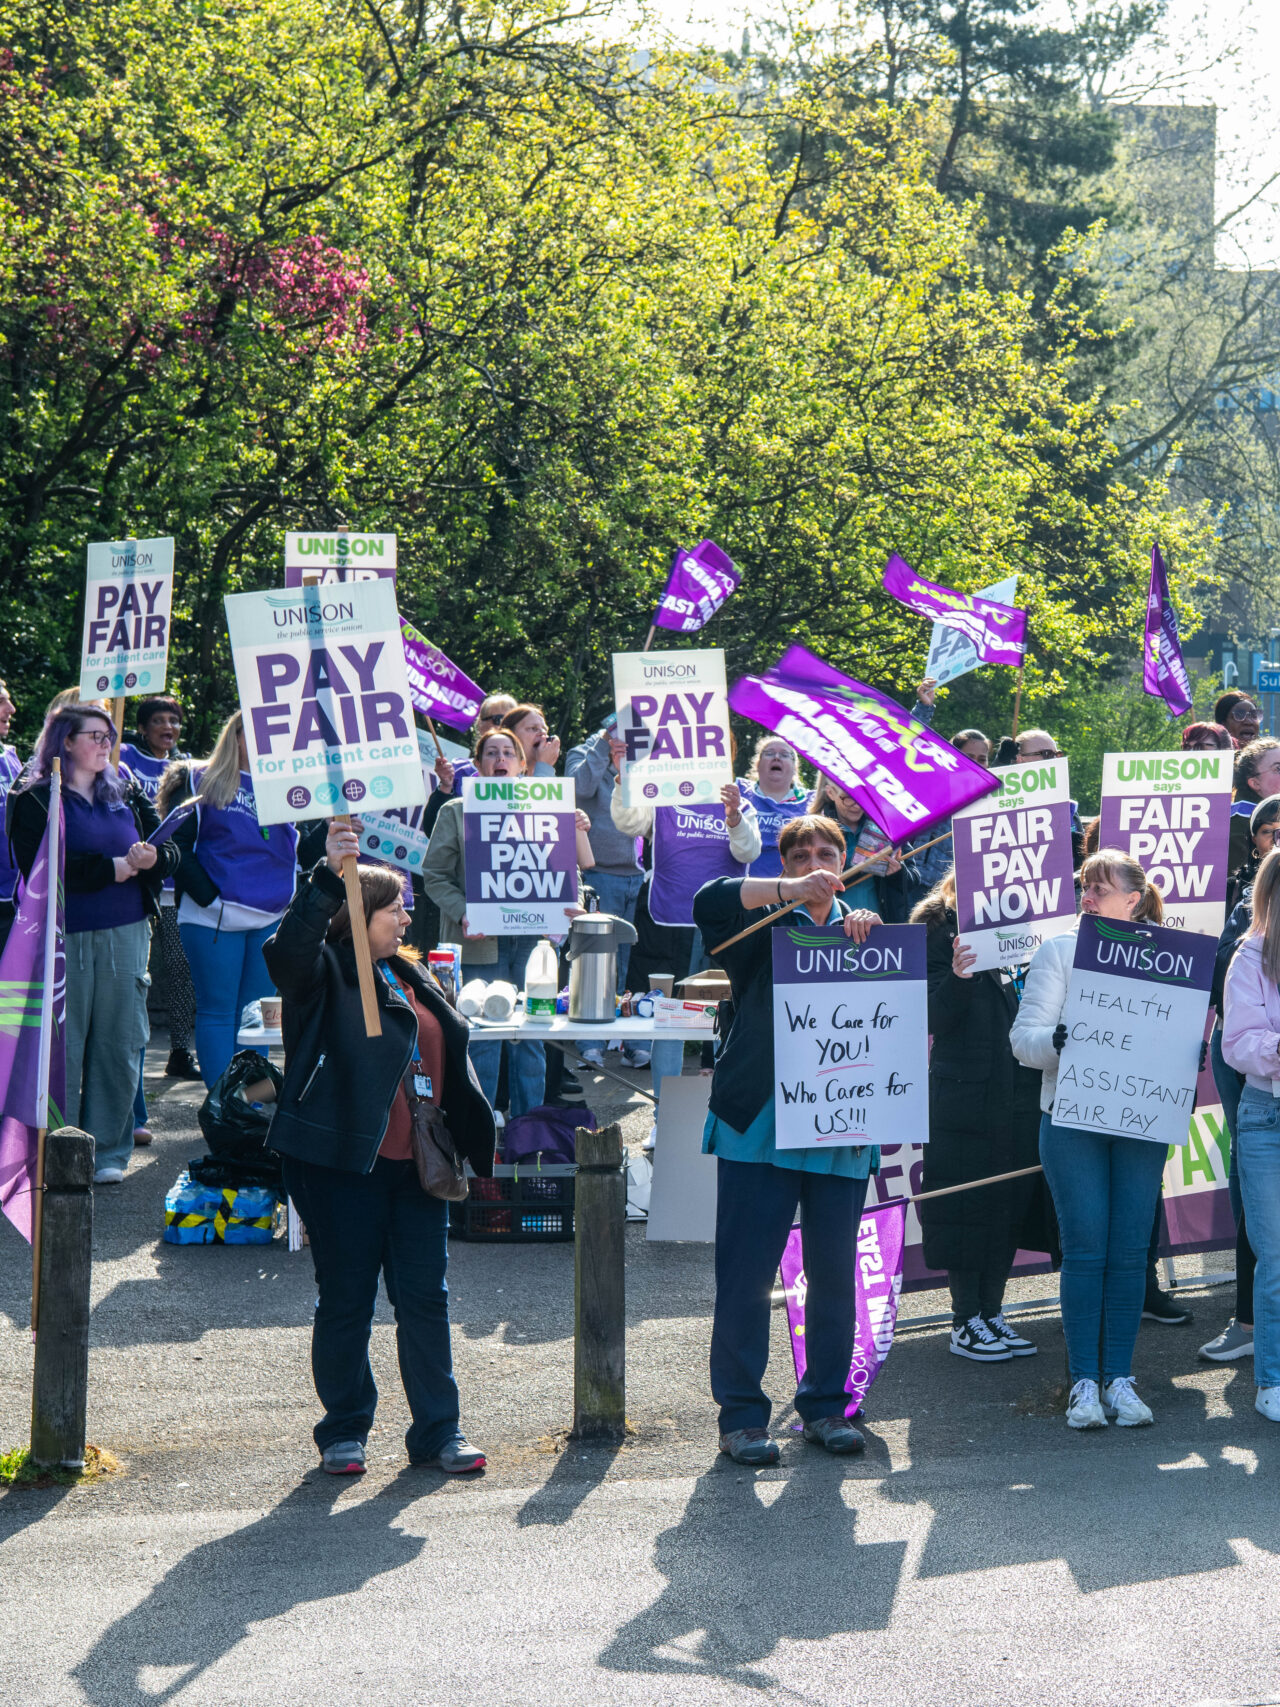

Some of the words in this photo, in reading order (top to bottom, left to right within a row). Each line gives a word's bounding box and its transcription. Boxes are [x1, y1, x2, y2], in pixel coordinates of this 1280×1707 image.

[112, 553, 153, 568] UNISON
[297, 537, 384, 556] UNISON
[329, 557, 353, 566] says
[97, 580, 164, 620] PAY
[273, 602, 354, 627] UNISON
[88, 614, 166, 654] FAIR
[277, 630, 289, 640] the
[290, 628, 312, 640] public
[315, 625, 339, 636] service
[341, 623, 363, 632] union
[86, 656, 101, 667] for
[104, 652, 140, 669] patient
[142, 650, 165, 662] care
[256, 641, 385, 703] PAY
[643, 664, 696, 679] UNISON
[251, 691, 409, 756] FAIR
[630, 692, 715, 728] PAY
[624, 725, 726, 761] FAIR
[257, 758, 285, 774] for
[292, 746, 364, 773] patient
[369, 744, 414, 761] care
[626, 763, 645, 774] for
[648, 760, 695, 775] patient
[699, 759, 728, 770] care
[1117, 758, 1220, 781] UNISON
[475, 783, 563, 801] UNISON
[1153, 782, 1182, 792] says
[507, 802, 532, 811] says
[998, 797, 1024, 808] says
[1119, 797, 1211, 831] FAIR
[361, 812, 376, 825] for
[377, 818, 415, 840] patient
[480, 814, 560, 842] FAIR
[677, 815, 729, 831] UNISO
[686, 831, 705, 839] public
[705, 832, 725, 840] service
[970, 808, 1054, 853] FAIR
[491, 843, 555, 871] PAY
[1129, 831, 1204, 865] PAY
[983, 844, 1050, 888] PAY
[481, 871, 565, 899] NOW
[1143, 864, 1214, 898] OW
[972, 877, 1062, 925] NOW
[503, 912, 544, 923] UNISON
[998, 934, 1043, 952] UNISON
[796, 947, 903, 974] UNISON
[1096, 940, 1194, 978] UNISON
[784, 1001, 817, 1032] We
[831, 1003, 864, 1030] Care
[870, 1001, 899, 1029] for
[1079, 988, 1172, 1021] HEALTH
[815, 1035, 870, 1065] YOU!
[1071, 1022, 1133, 1051] CARE
[780, 1081, 817, 1104] Who
[825, 1078, 874, 1102] Cares
[885, 1072, 913, 1096] for
[1059, 1064, 1194, 1108] ASSISTANT
[814, 1108, 866, 1135] US!!!
[1056, 1098, 1108, 1125] FAIR
[1119, 1107, 1158, 1133] PAY
